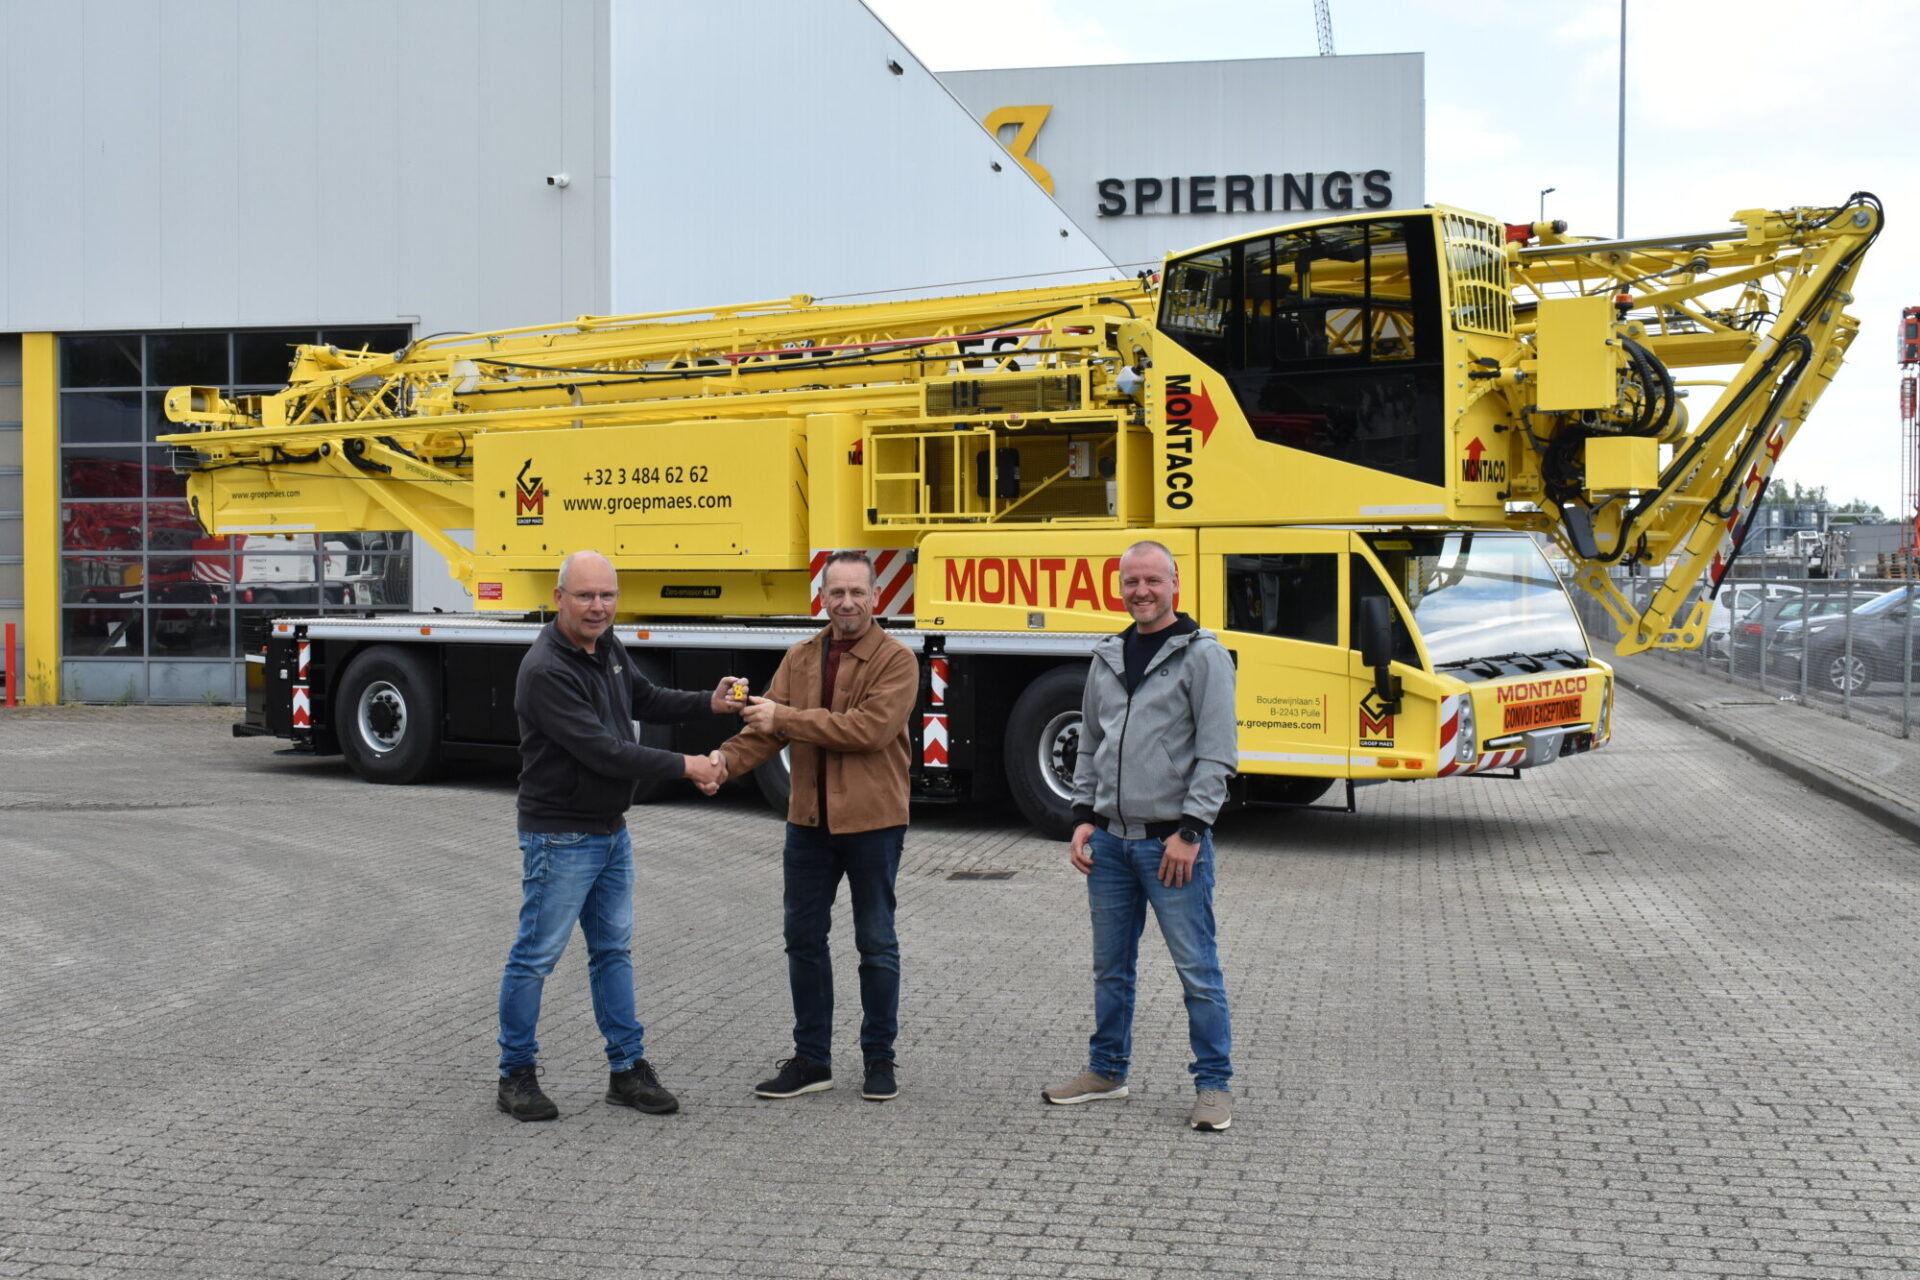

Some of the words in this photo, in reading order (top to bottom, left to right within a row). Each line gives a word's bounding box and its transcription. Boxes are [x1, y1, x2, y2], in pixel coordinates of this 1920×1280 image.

[1098, 169, 1393, 217] SPIERINGS
[1165, 374, 1193, 509] MONTACO
[583, 469, 612, 486] +32
[618, 468, 626, 485] 3
[632, 467, 660, 484] 484
[665, 466, 683, 483] 62
[689, 465, 708, 483] 62
[1462, 459, 1505, 483] MONTACO
[563, 494, 732, 515] www.groepmaes.com
[945, 557, 1179, 613] MONTAC
[934, 616, 944, 625] 6
[1497, 676, 1587, 703] MONTACO
[1256, 696, 1313, 706] Boudewijnlaan
[1270, 708, 1298, 717] B-2243
[1301, 709, 1320, 717] Pulle
[1505, 705, 1532, 729] CONVOI
[1534, 698, 1581, 724] EXCEPTIONNEL
[1236, 720, 1321, 730] w.groepmaes.com
